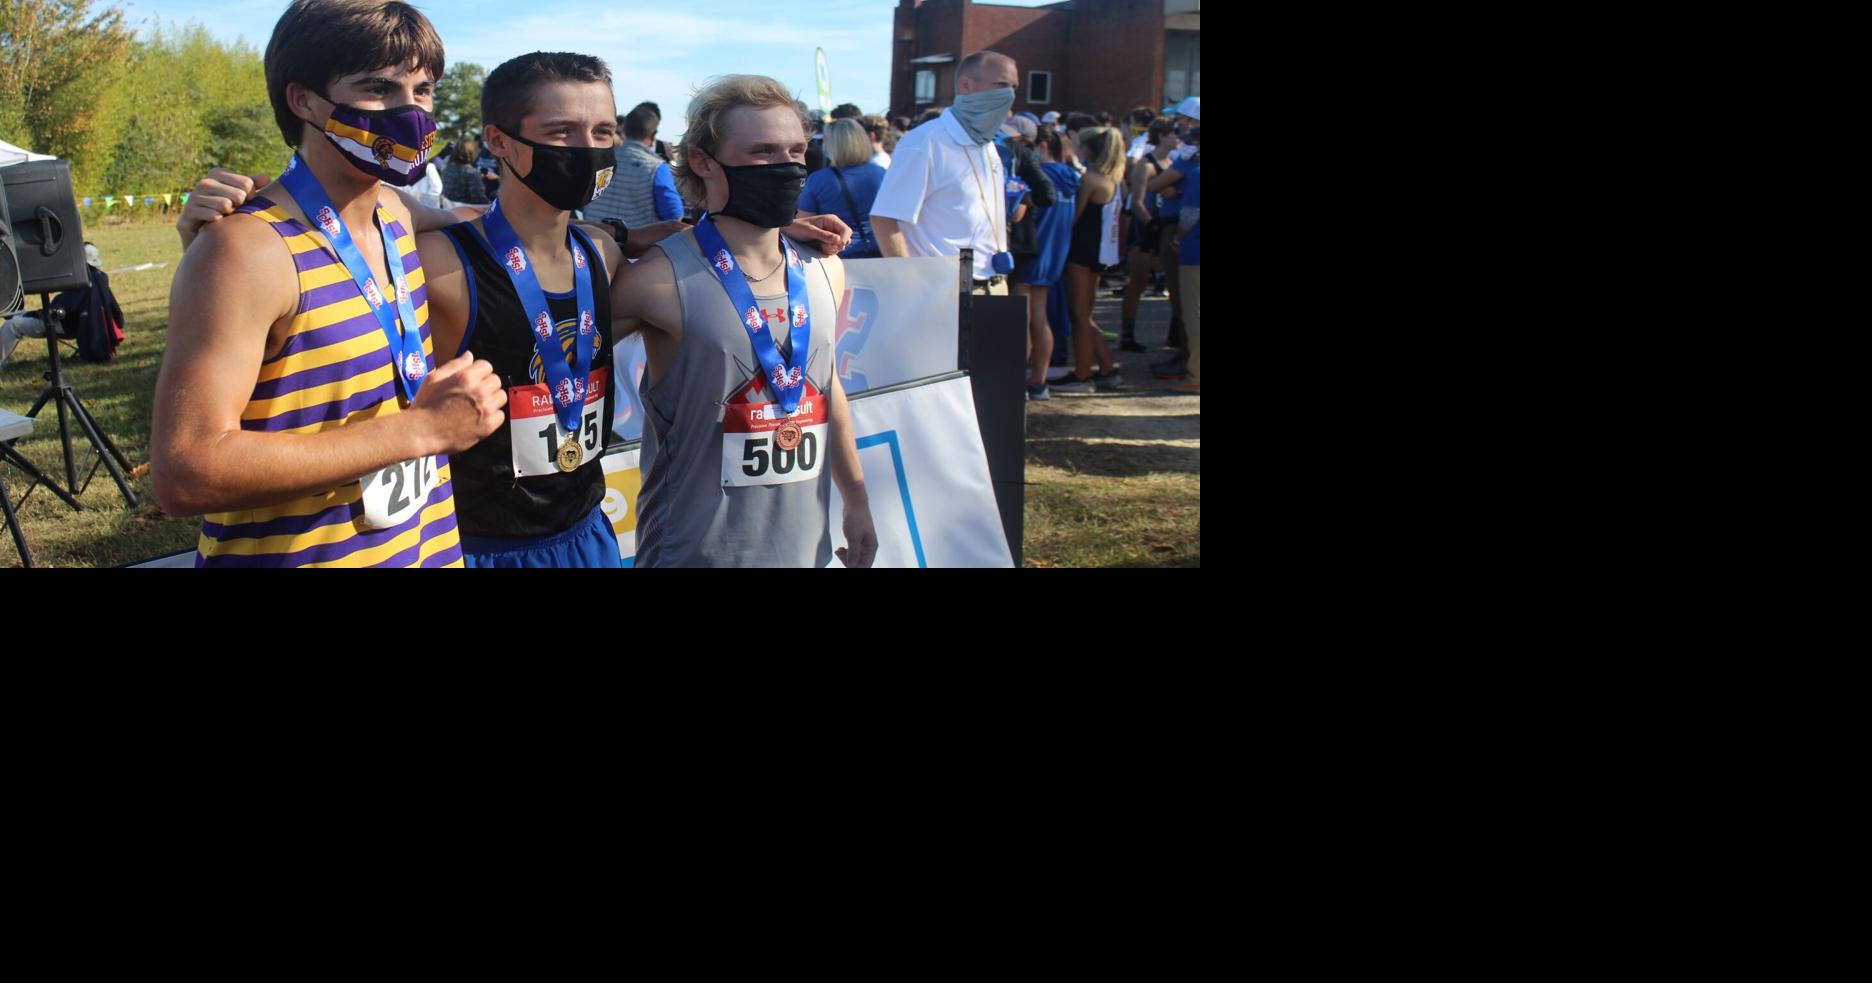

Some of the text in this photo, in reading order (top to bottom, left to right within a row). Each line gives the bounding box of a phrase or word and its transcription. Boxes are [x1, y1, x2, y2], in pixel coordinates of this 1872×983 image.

[506, 247, 523, 275] SCHSL
[715, 250, 732, 276] SCHSL
[536, 313, 552, 341] SCHSL
[555, 378, 571, 407] SCHSL
[539, 411, 598, 463] 15
[742, 432, 817, 477] 500
